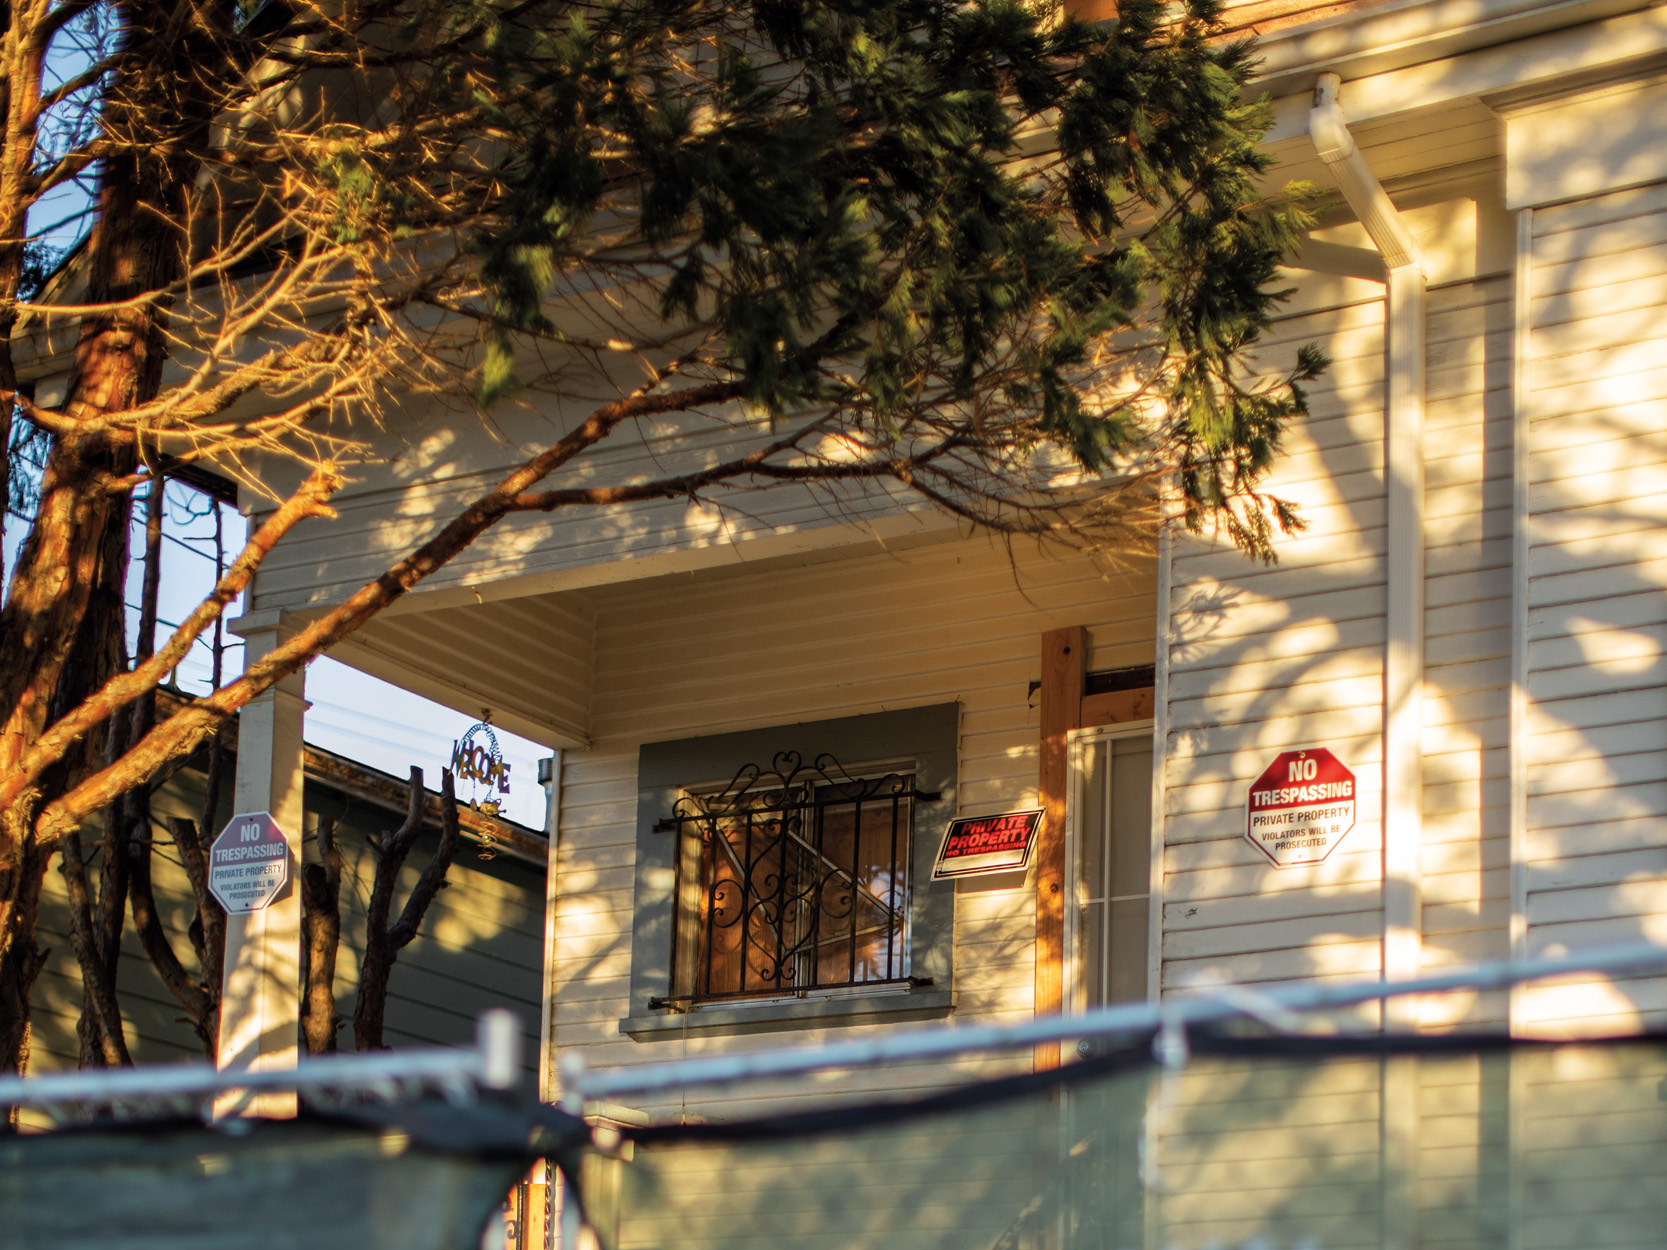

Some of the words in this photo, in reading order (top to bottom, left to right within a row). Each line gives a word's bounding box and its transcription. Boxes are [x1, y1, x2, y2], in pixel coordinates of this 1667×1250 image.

[1288, 758, 1318, 782] NO
[1252, 780, 1353, 807] TRESPASSING
[961, 815, 1029, 835] PRIVATE
[1253, 812, 1294, 827] PRIVATE
[1297, 806, 1350, 823] PROPERTY
[240, 823, 260, 842] NO
[947, 827, 1032, 850] PROPERTY
[1261, 828, 1306, 841] VIOLATORS
[1308, 826, 1327, 836] WILL
[1330, 824, 1341, 834] BE
[215, 842, 284, 862] TRESPASSING
[945, 849, 960, 857] NO
[962, 841, 1027, 855] TRESPASSING
[1274, 837, 1327, 851] PROSECUTED
[215, 868, 244, 879] PRIVATE
[245, 864, 282, 876] PROPERTY
[220, 882, 251, 892] VIOLATORS
[252, 881, 266, 889] WILL
[267, 879, 275, 887] BE
[229, 890, 266, 900] PROSECUTED
